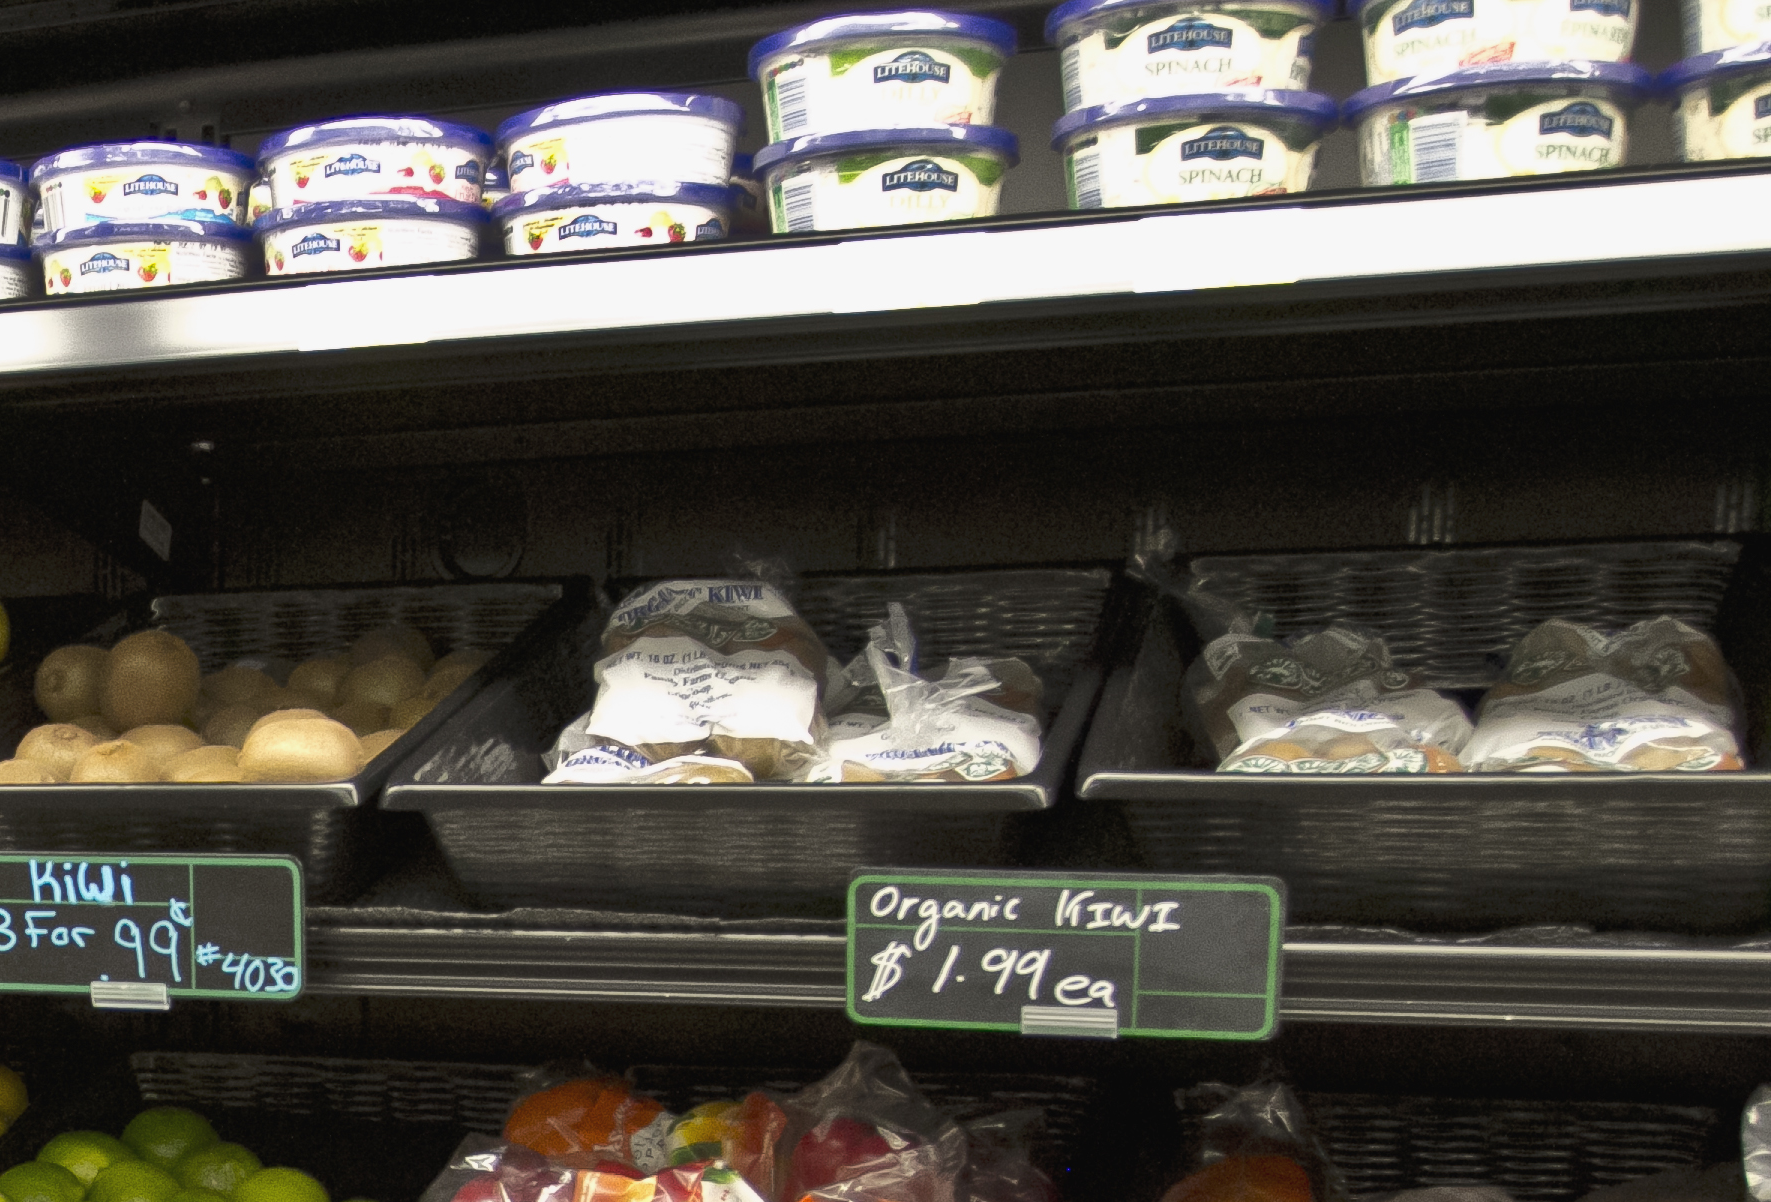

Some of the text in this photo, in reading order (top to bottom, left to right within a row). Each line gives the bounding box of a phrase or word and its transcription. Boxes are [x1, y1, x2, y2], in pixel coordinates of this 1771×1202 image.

[1151, 29, 1229, 48] LITEHOUSE
[875, 62, 948, 80] LITEHOUSE
[1145, 58, 1232, 76] SPINACH
[1185, 139, 1260, 155] LITEHOUSE
[1535, 144, 1610, 164] SPINACH
[325, 160, 380, 177] LITEHOUSE
[1179, 168, 1263, 184] SPINACH
[124, 181, 179, 195] LITEHOUSE
[884, 171, 957, 189] LITEHOUSE
[559, 219, 617, 238] LITEHOUSE
[293, 239, 339, 257] LITEHOUSE
[81, 258, 129, 275] LITEHOUSE
[708, 585, 764, 602] KIWI
[870, 886, 1021, 950] Organic
[25, 911, 95, 947] For
[196, 942, 300, 992] #4030
[1054, 974, 1117, 1008] ea
